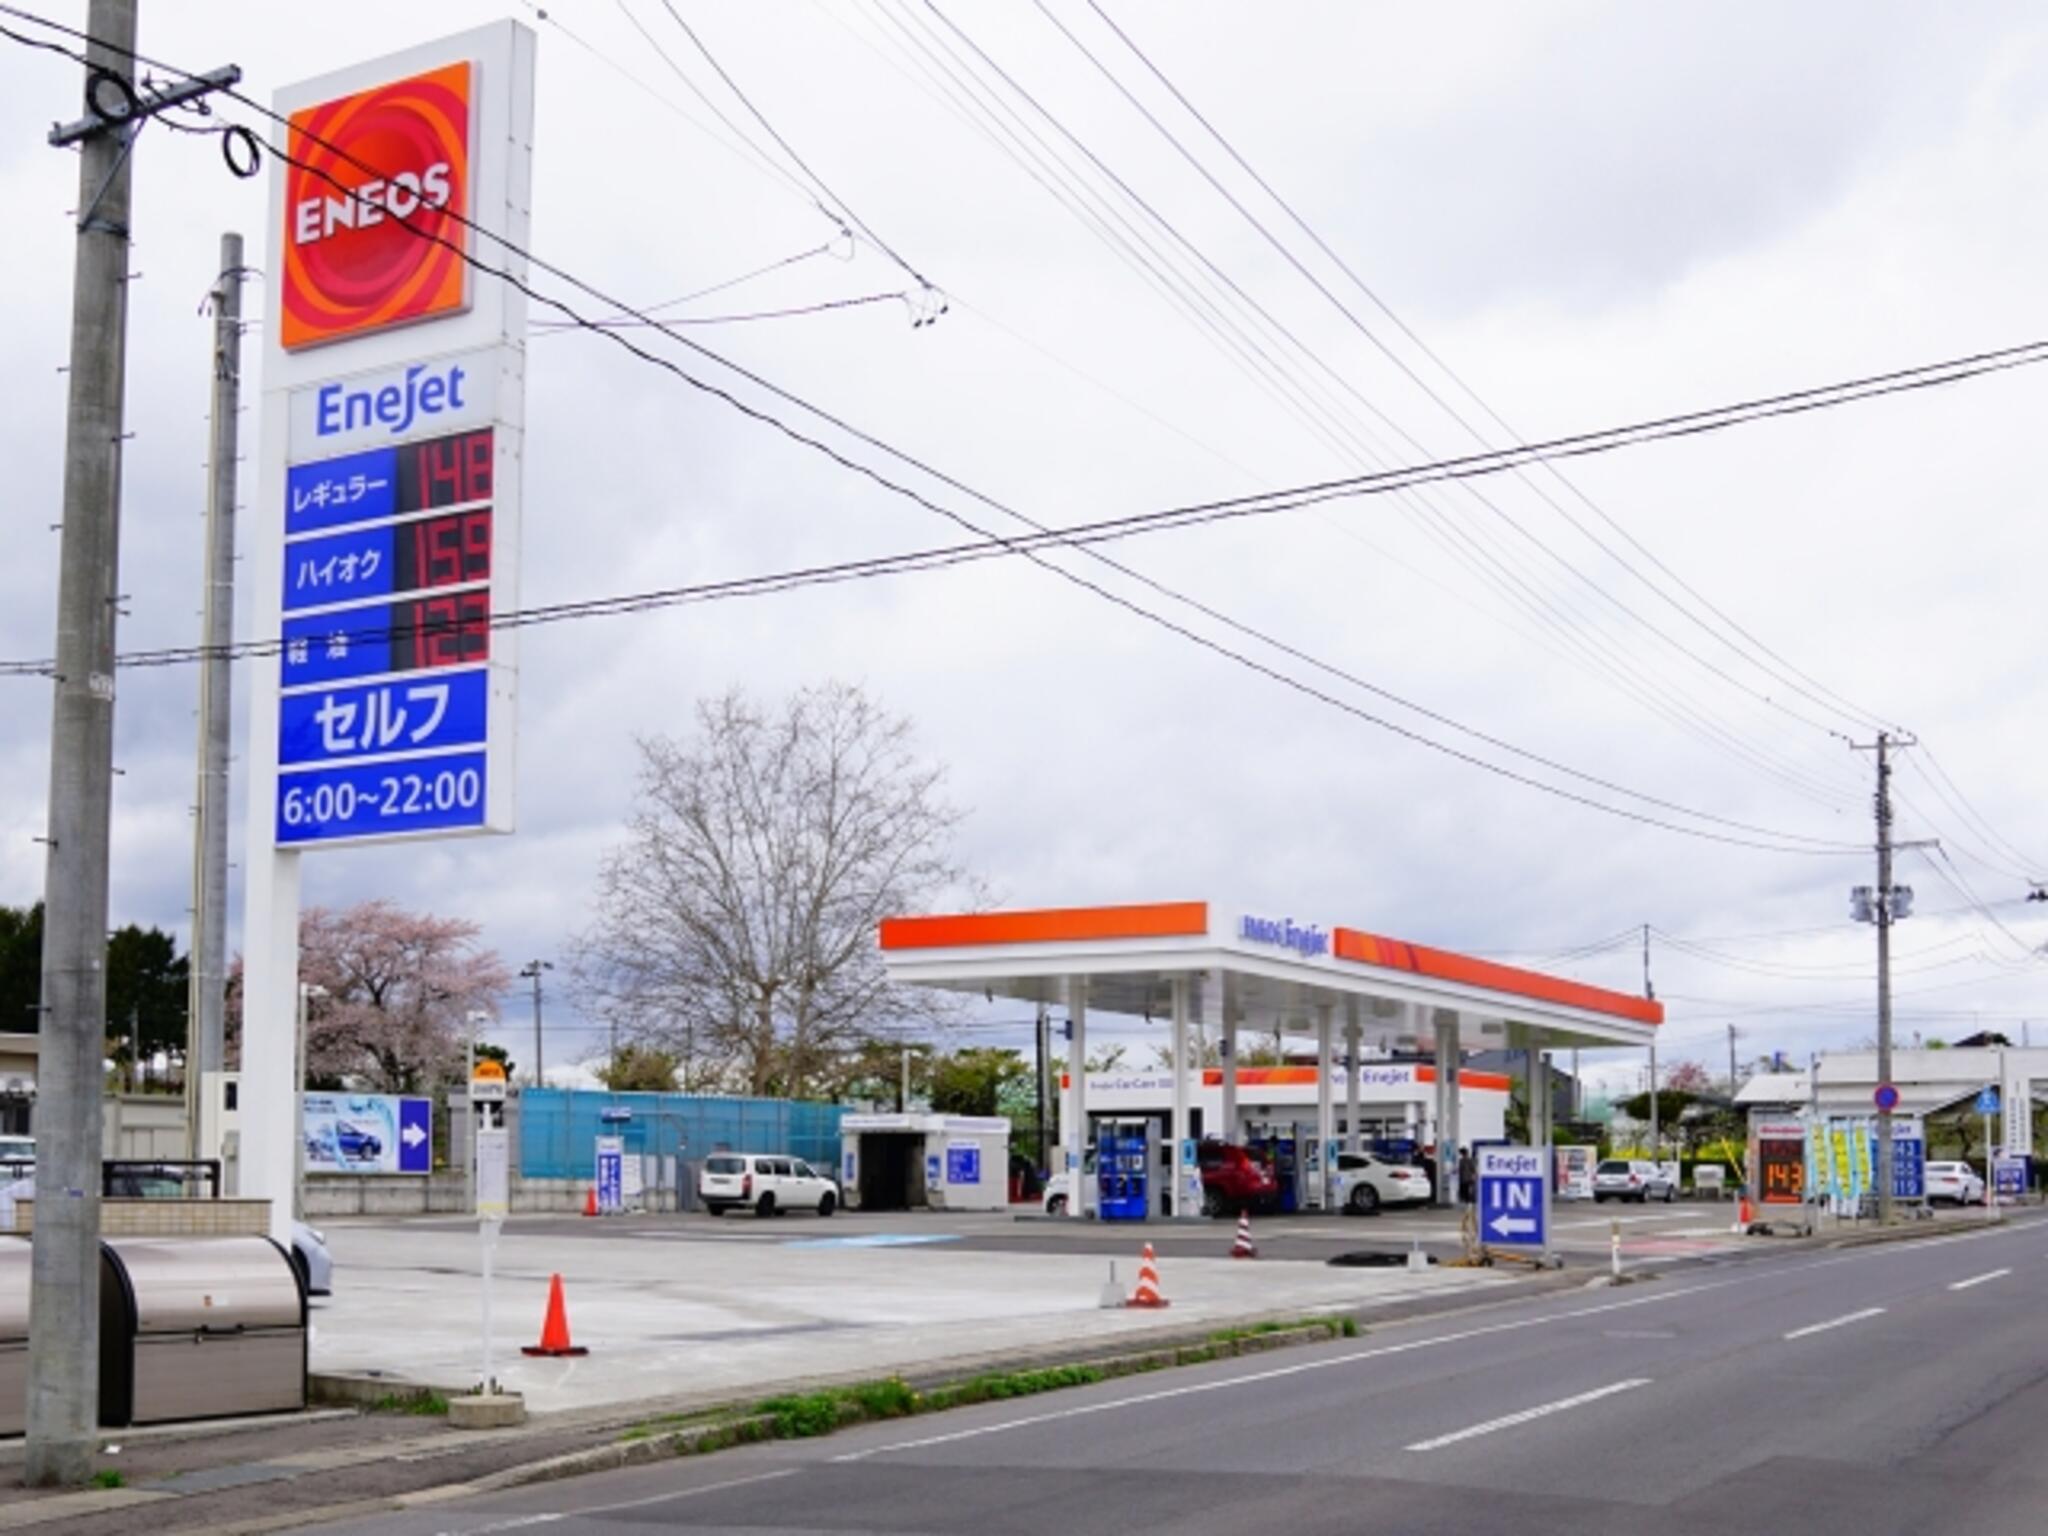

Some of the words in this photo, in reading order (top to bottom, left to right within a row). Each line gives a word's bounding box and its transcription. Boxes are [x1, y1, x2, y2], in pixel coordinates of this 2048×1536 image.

[296, 164, 450, 244] ENEOS
[293, 475, 388, 512] レギュラー
[418, 430, 493, 511] 148
[297, 549, 382, 589] ハイオク
[415, 509, 491, 588] 159
[413, 594, 489, 668] 123
[315, 684, 449, 752] セルフ
[1492, 1182, 1532, 1209] IN
[1768, 1162, 1804, 1194] 143
